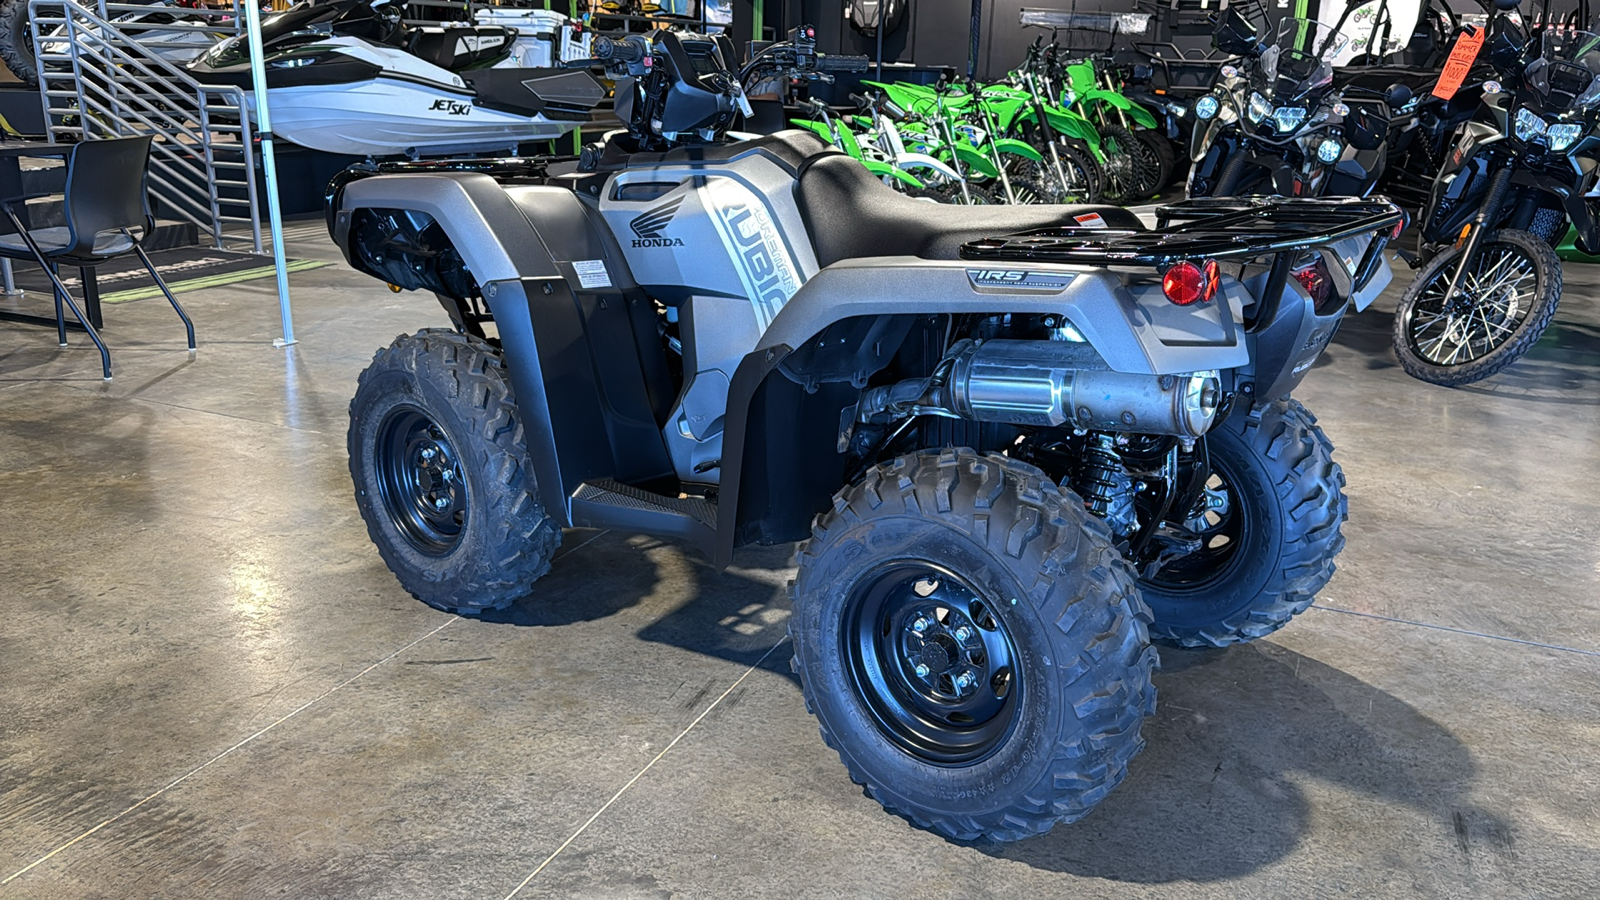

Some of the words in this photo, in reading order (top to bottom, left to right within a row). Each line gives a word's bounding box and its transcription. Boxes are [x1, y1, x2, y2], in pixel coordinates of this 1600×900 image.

[631, 237, 686, 248] HONDA
[754, 205, 798, 296] OREMAN
[977, 270, 1024, 280] IRS
